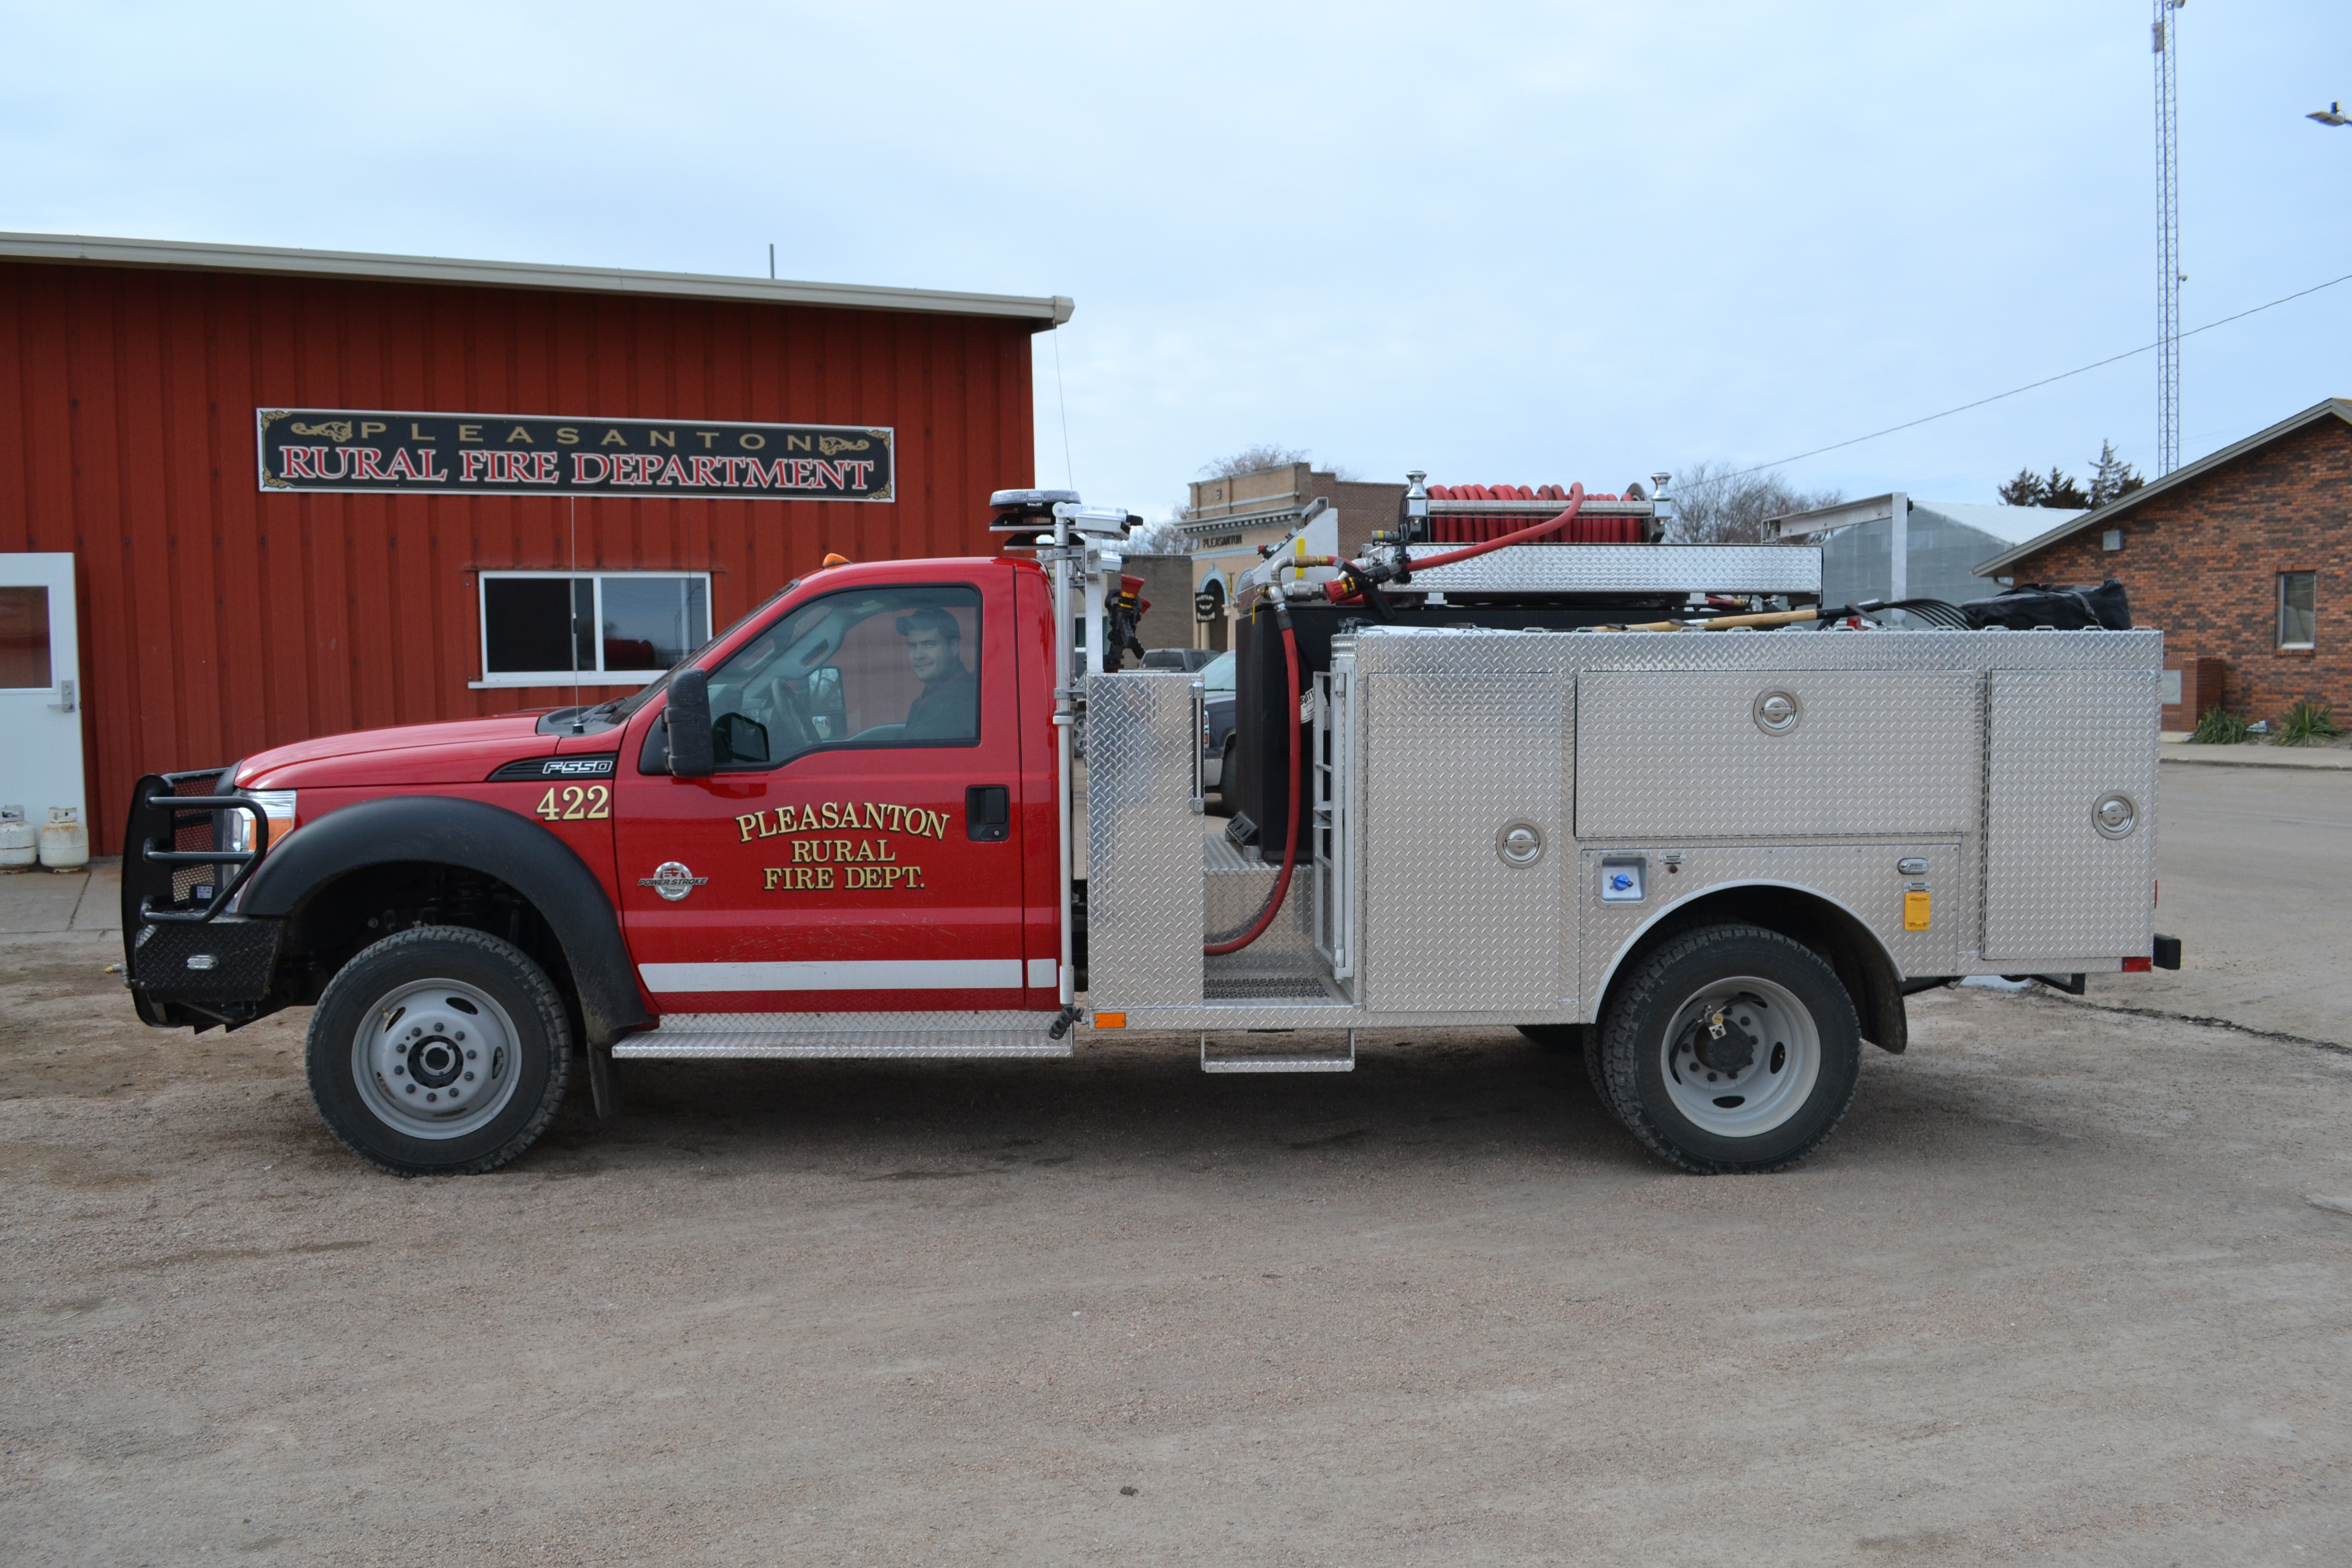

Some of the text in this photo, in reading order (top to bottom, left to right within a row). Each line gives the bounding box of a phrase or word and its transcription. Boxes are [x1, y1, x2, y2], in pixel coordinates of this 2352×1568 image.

[361, 422, 811, 452] PLEASANTON
[279, 445, 873, 490] RURAL FIRE DEPARTMENT
[1203, 534, 1242, 548] PLEASANTON
[536, 785, 609, 821] 422
[736, 801, 950, 843] PLEASANTON
[791, 840, 896, 863] RURAL
[764, 866, 925, 891] FIRE DEPT.
